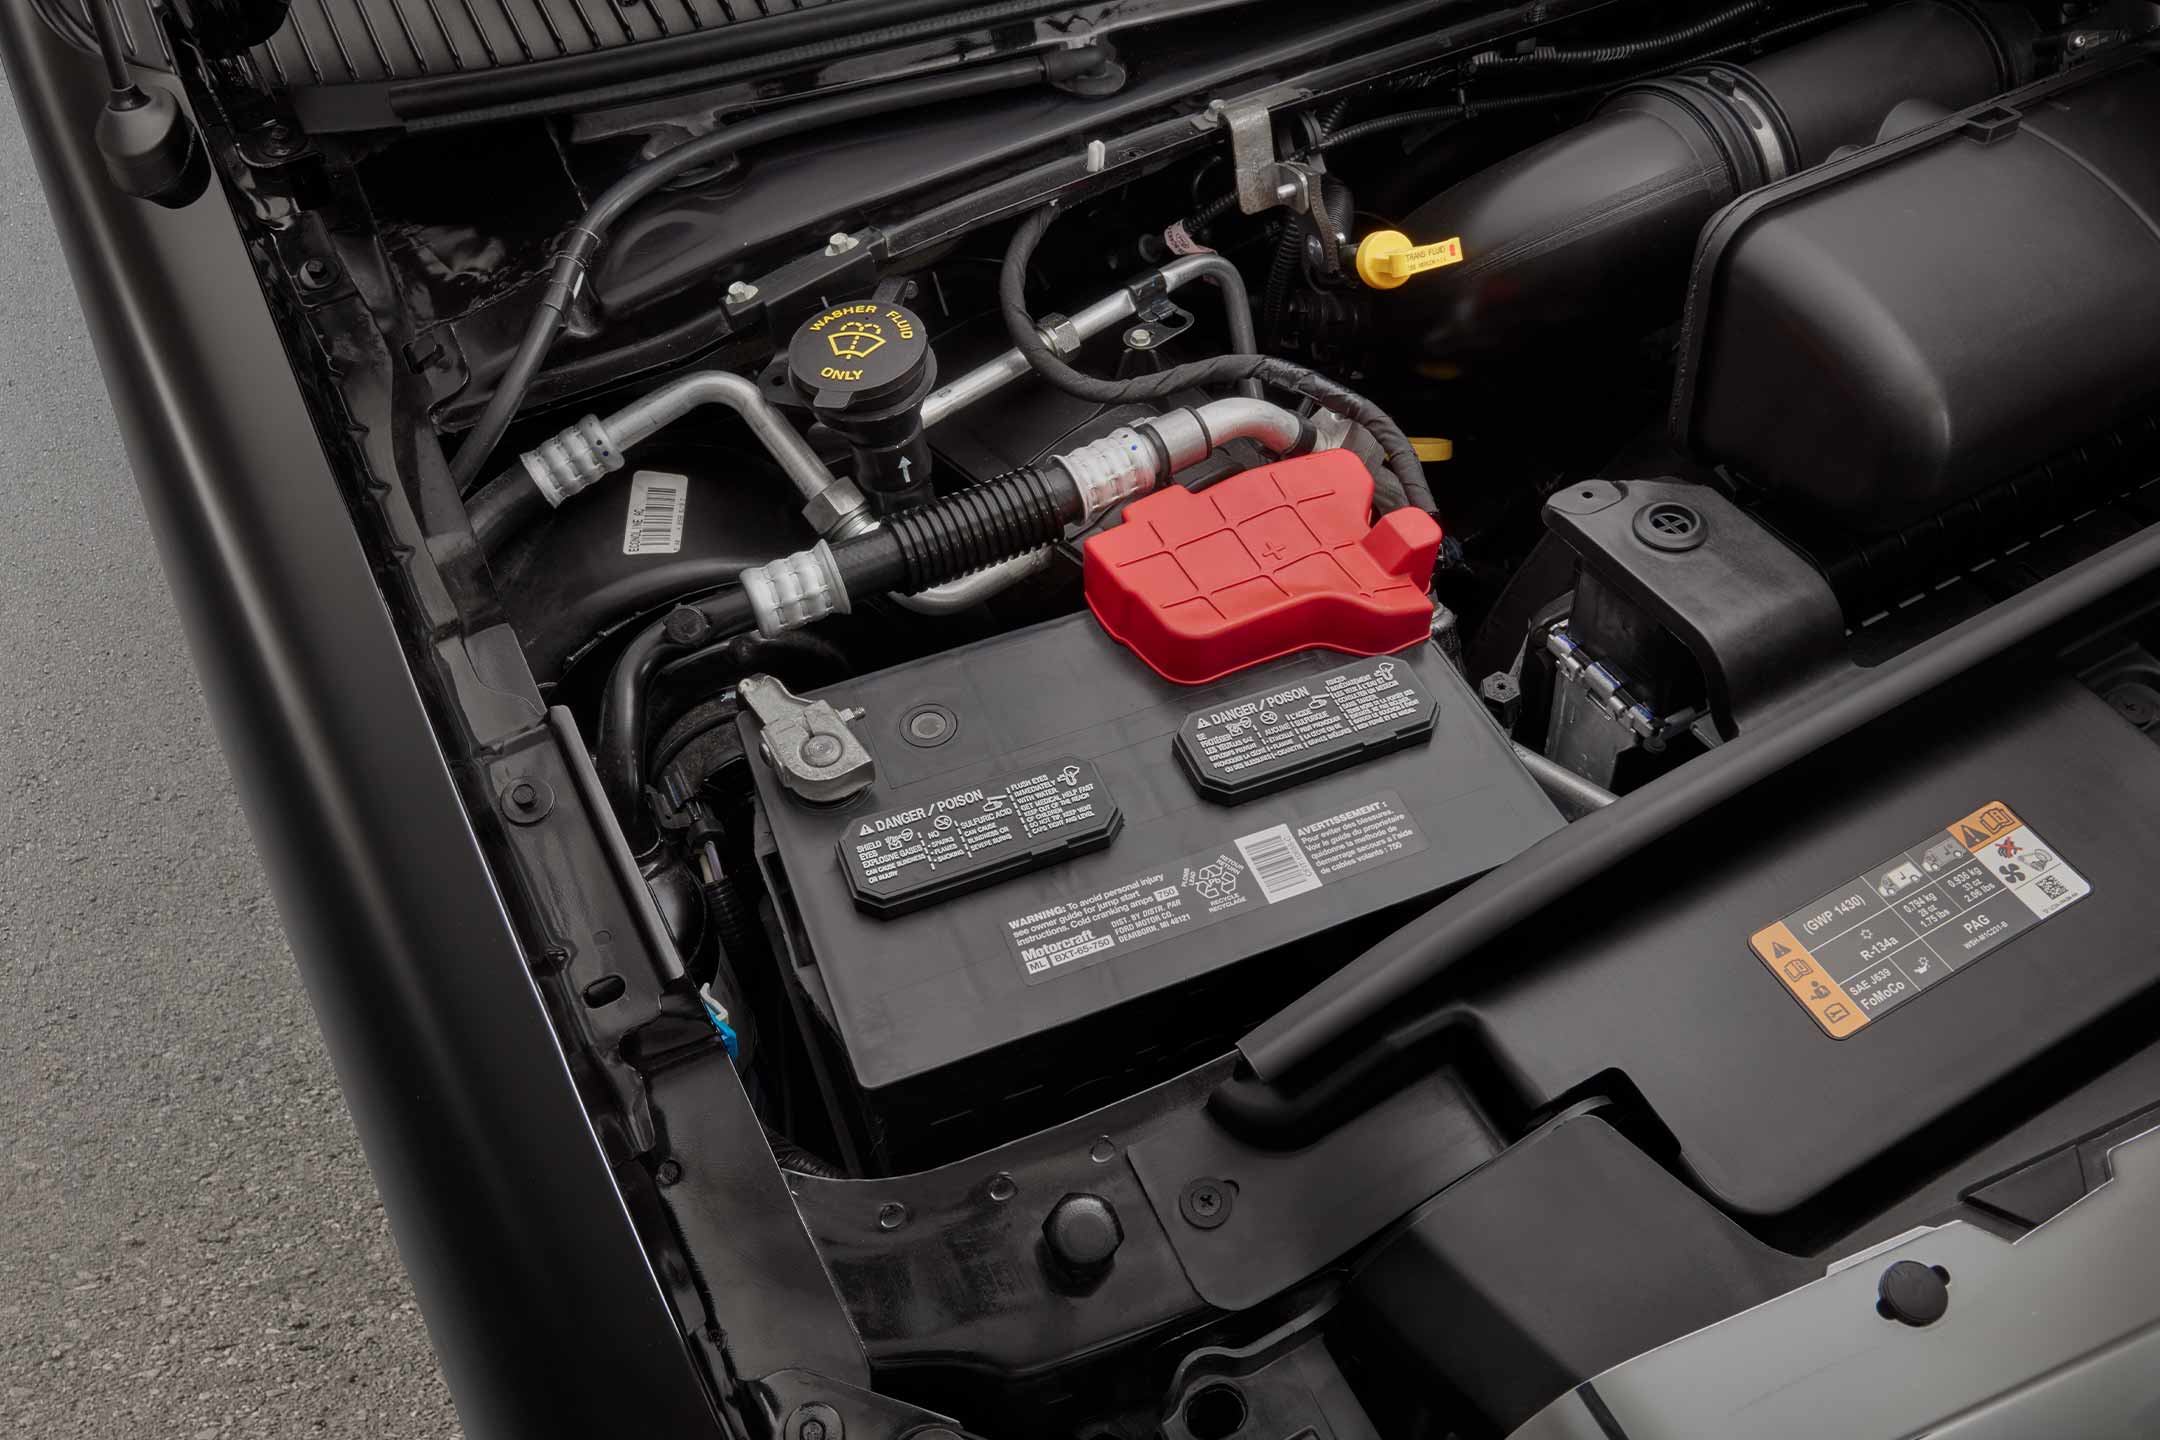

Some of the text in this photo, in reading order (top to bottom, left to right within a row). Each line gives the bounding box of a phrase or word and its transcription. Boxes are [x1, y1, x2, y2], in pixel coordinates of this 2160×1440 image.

[1406, 251, 1426, 261] TRANS
[809, 305, 913, 339] WASHER FLUID
[820, 367, 863, 380] ONLY
[1210, 702, 1258, 725] DANGER
[1266, 686, 1310, 708] POISON
[1010, 779, 1032, 791] FLUSH
[874, 807, 926, 832] DANGER
[937, 789, 983, 812] POISON
[960, 808, 1013, 829] SULFURIC ACID
[1297, 801, 1381, 837] AVERTISSEMENT
[928, 830, 940, 839] NO
[1301, 834, 1320, 844] Pour
[1342, 821, 1357, 830] des
[1305, 843, 1321, 851] Voir
[1330, 832, 1351, 845] guide
[1352, 828, 1362, 836] du
[1387, 825, 1398, 833] de
[856, 840, 882, 853] SHIELD
[860, 850, 878, 860] EYES
[1356, 839, 1386, 852] secours
[862, 844, 923, 869] EXPLOSIVE GASES
[1220, 854, 1244, 870] RETOUR
[1331, 858, 1357, 871] cables
[865, 867, 878, 876] CAN
[1188, 871, 1196, 886] LEAD
[1947, 867, 1983, 888] 0.936 kg
[1962, 882, 1973, 891] 33
[1964, 883, 1996, 903] 2.06 lbs
[1008, 873, 1164, 930] WARNING: To avoid personal injury
[1210, 893, 1241, 906] RECYCLE
[1903, 892, 1938, 913] 0.794 kg
[1013, 890, 1141, 939] see owner guide for jump start
[1016, 888, 1175, 947] instructions. Cold cranking amps 750
[1111, 899, 1181, 928] DIST. BY DISTR. PAR
[1115, 910, 1175, 936] FORD MOTOR CO.
[1160, 921, 1170, 929] MI
[1170, 913, 1191, 925] 48121
[1803, 894, 1867, 936] (GWP 1430)
[1920, 909, 1950, 928] 1.75 lbs
[1963, 914, 1990, 934] PAG
[1021, 929, 1097, 962] Motorcraft
[1030, 938, 1110, 971] ML BXT-65-750
[1860, 935, 1899, 962] R-134a
[1850, 968, 1892, 998] SAE J639
[1861, 980, 1905, 1011] FoMoCo
